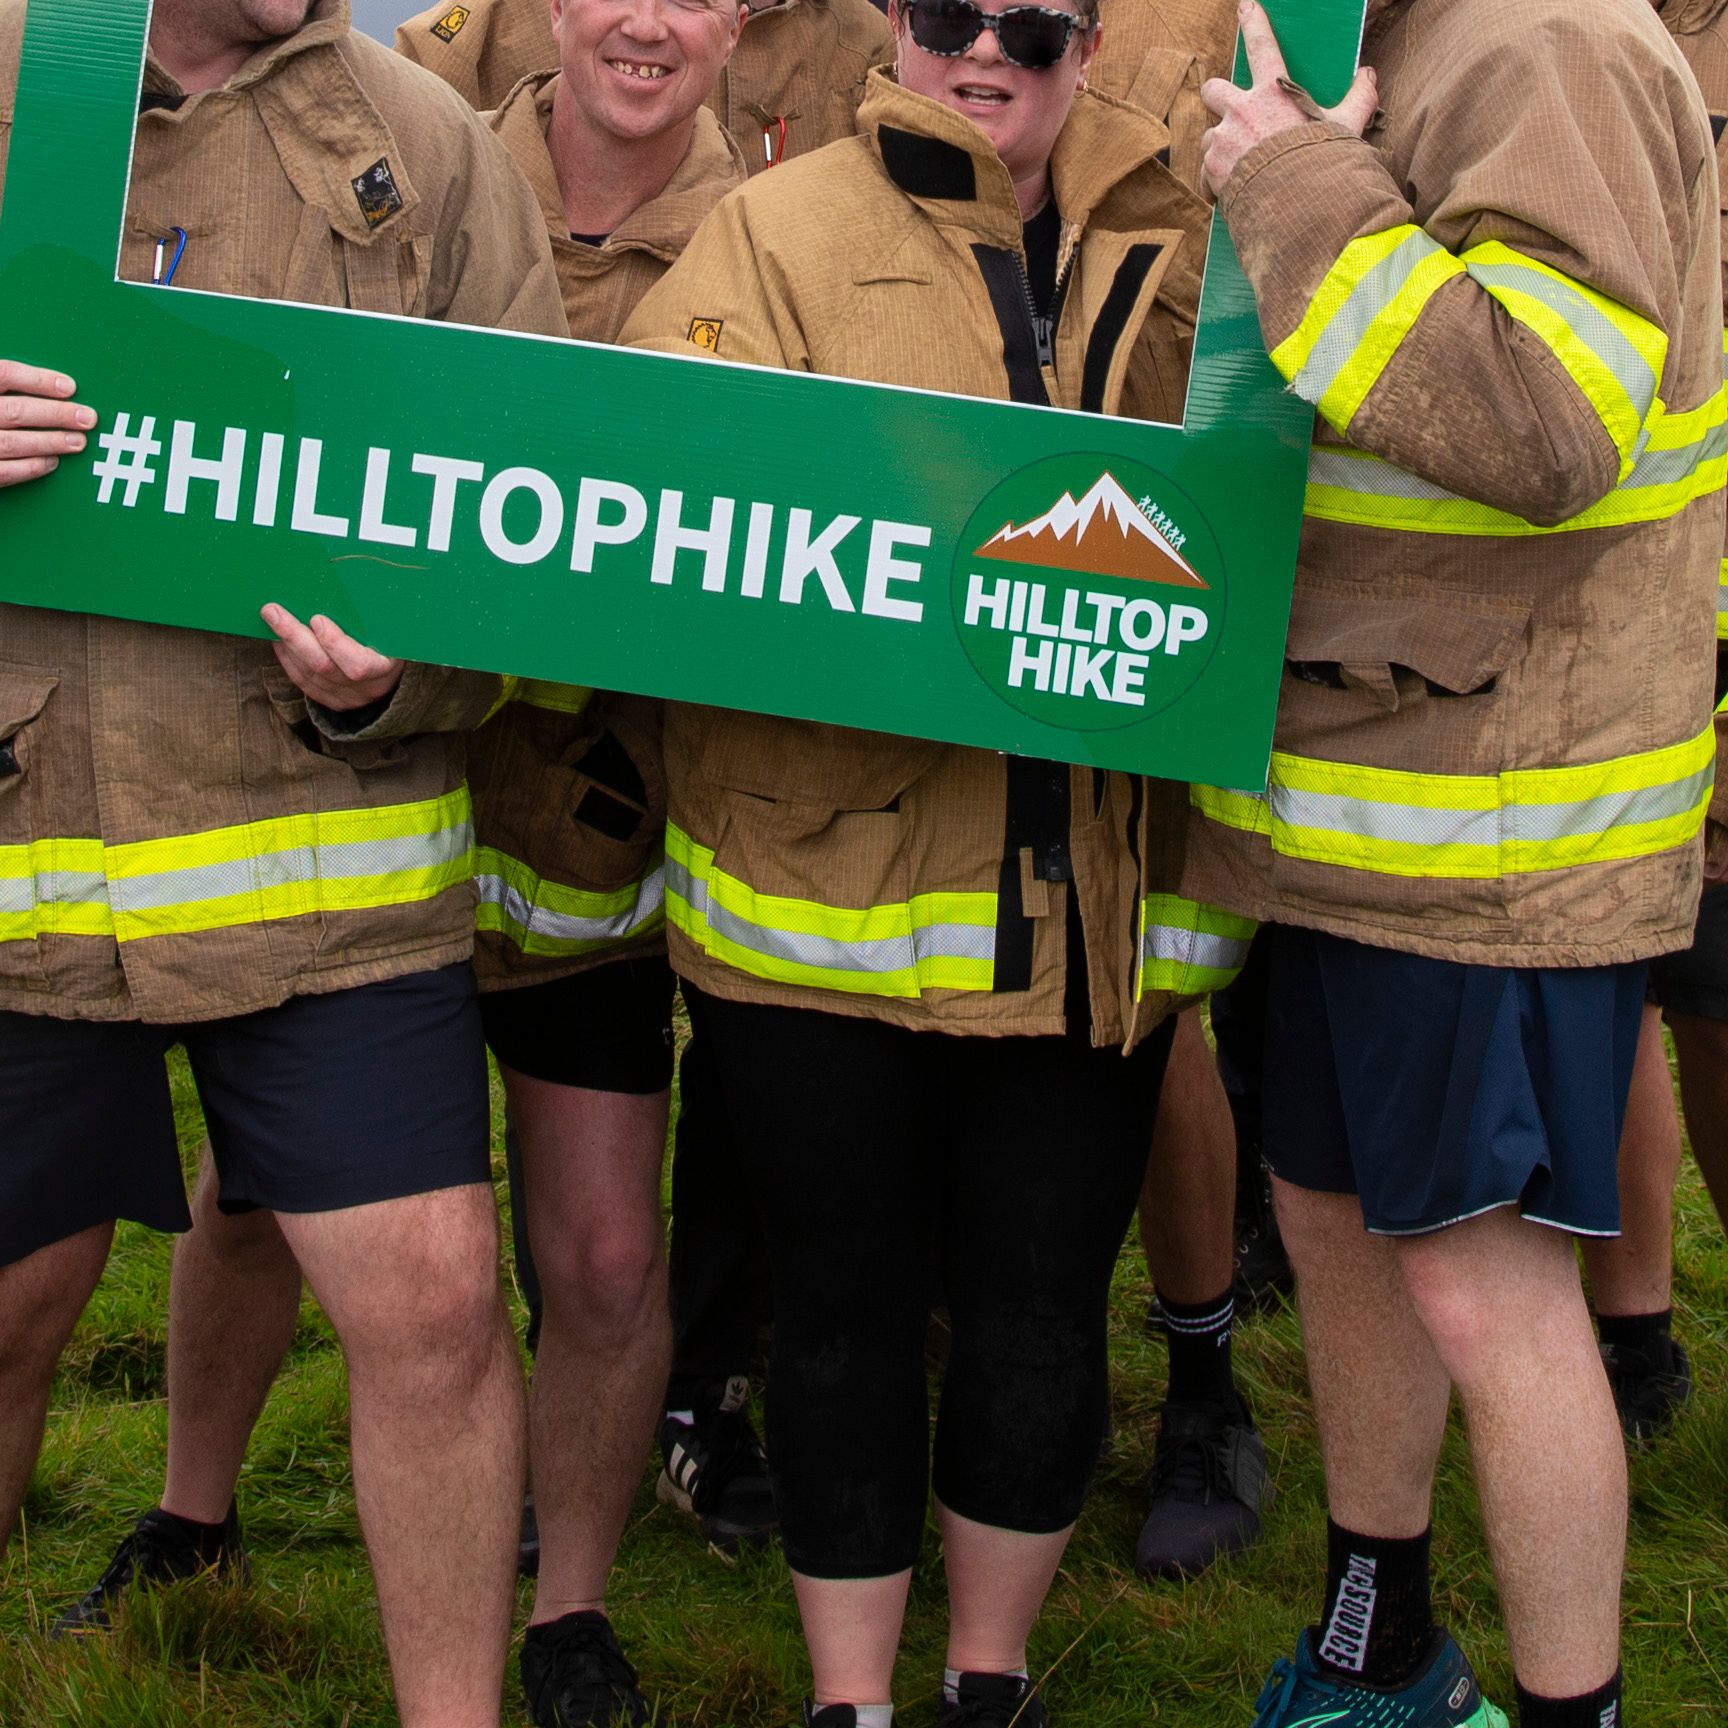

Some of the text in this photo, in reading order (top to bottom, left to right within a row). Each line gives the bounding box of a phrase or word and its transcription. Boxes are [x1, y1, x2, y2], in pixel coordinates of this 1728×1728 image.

[92, 412, 932, 622] #HILLTOPHIKE
[964, 574, 1209, 656] HILLTOP
[1007, 636, 1150, 706] HIKE
